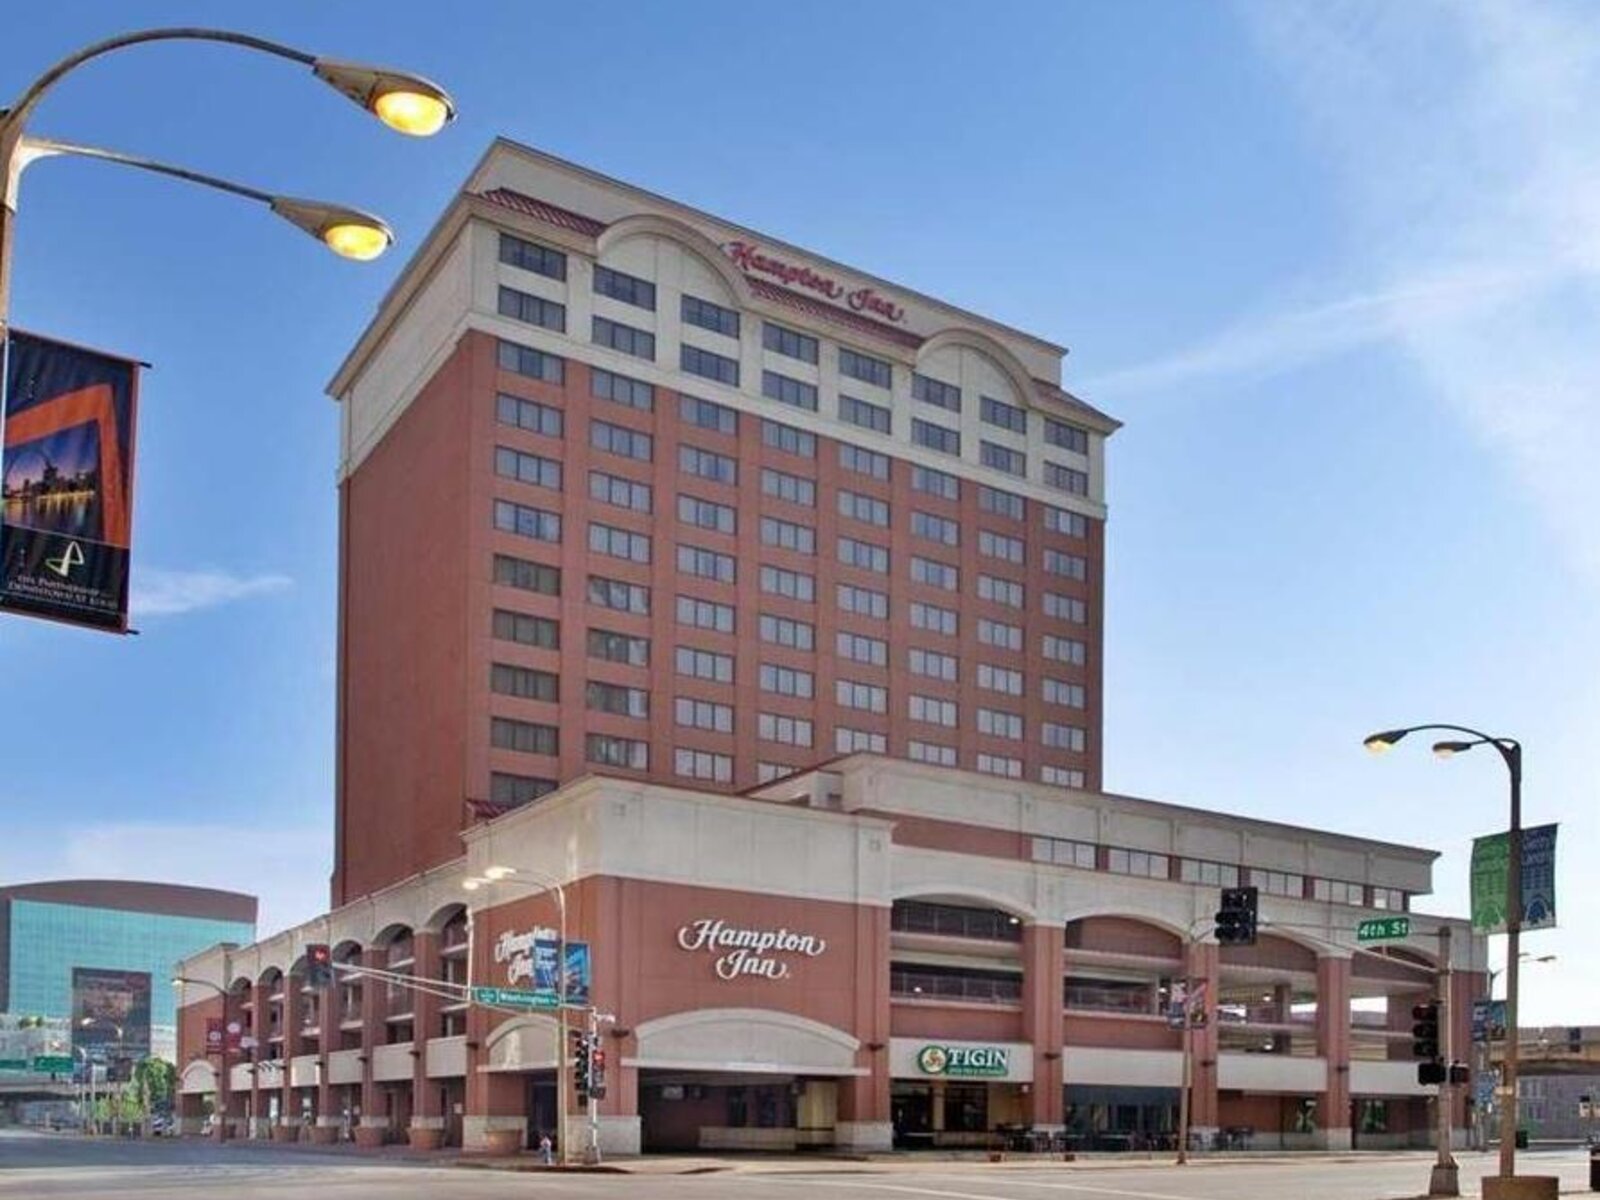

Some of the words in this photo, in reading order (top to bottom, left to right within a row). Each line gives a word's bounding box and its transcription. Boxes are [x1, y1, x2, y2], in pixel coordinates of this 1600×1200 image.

[719, 240, 844, 299] Hampton
[848, 288, 904, 322] Inn
[678, 919, 827, 957] Hampton
[1360, 923, 1386, 937] 4th
[1391, 921, 1407, 935] St
[716, 949, 788, 980] Inn
[948, 1048, 1008, 1067] TIGIN
